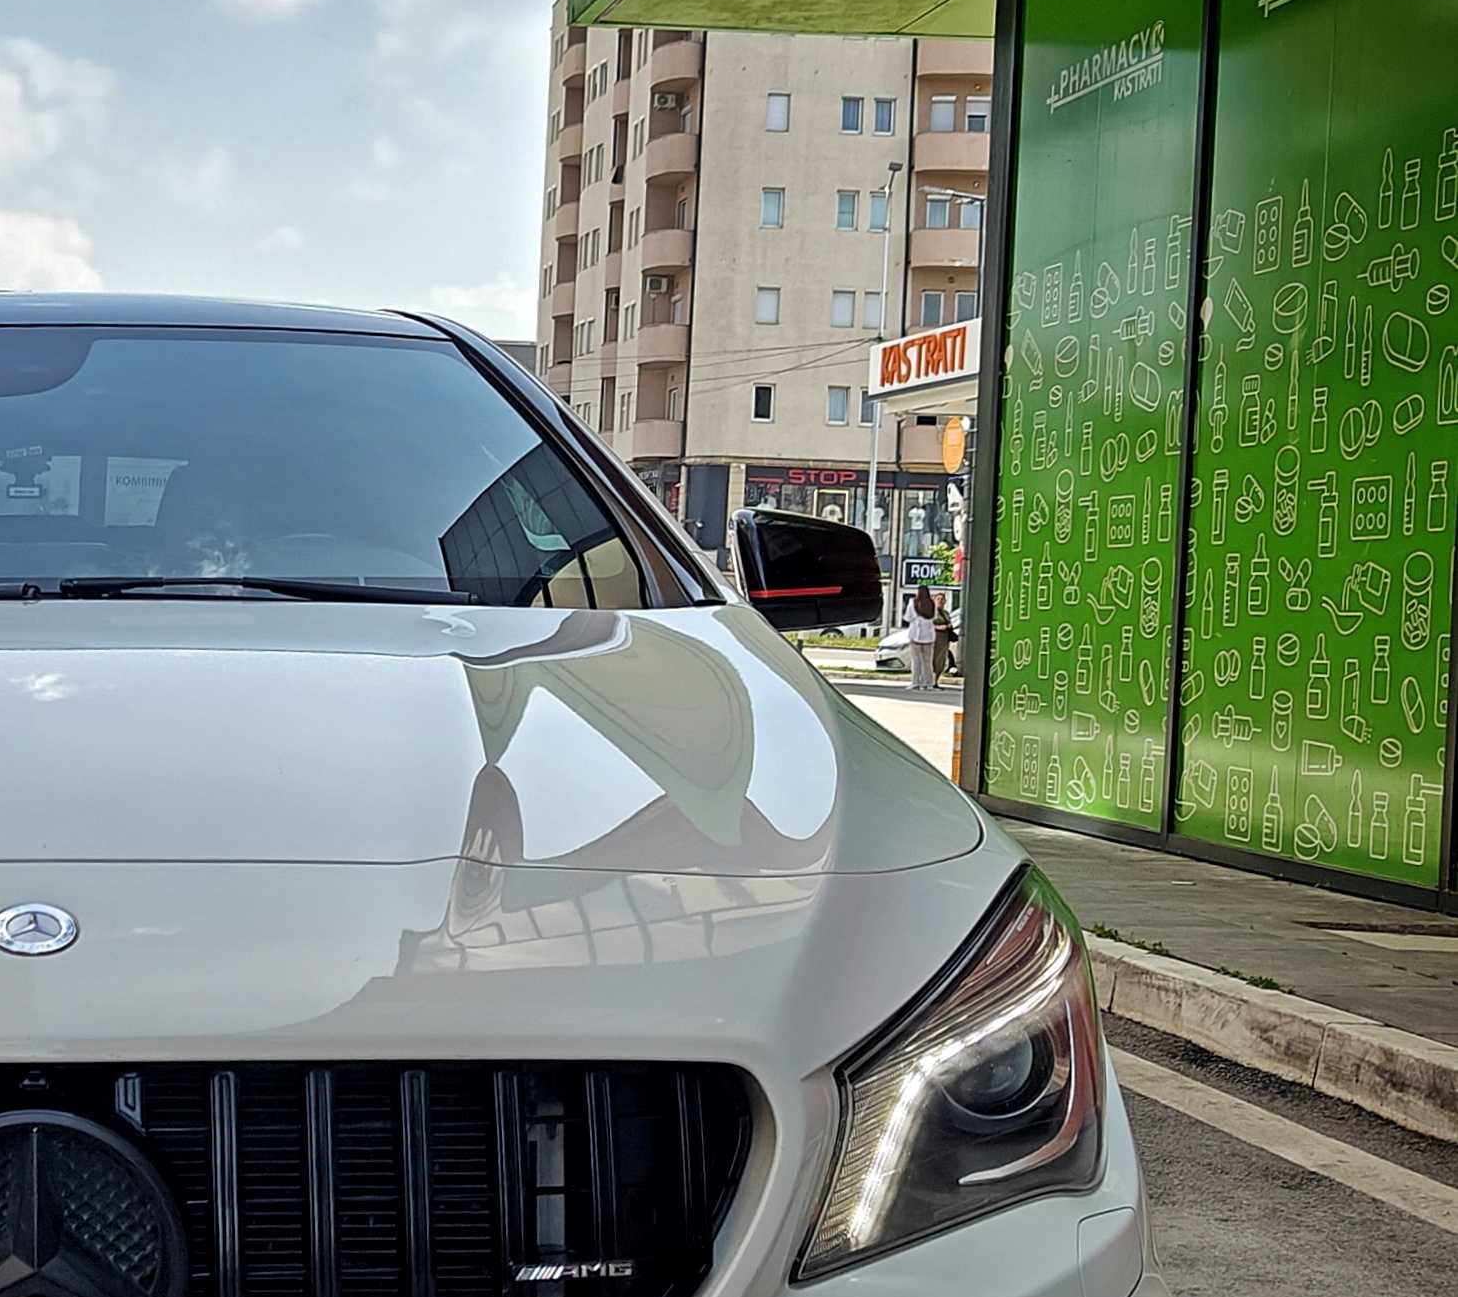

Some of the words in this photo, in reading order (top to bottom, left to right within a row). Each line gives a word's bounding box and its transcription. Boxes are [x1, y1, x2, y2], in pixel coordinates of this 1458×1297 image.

[1059, 27, 1151, 99] PHARMACY
[1113, 60, 1162, 102] KASTRATI
[880, 326, 967, 388] KASTRATI
[787, 468, 857, 485] STOP
